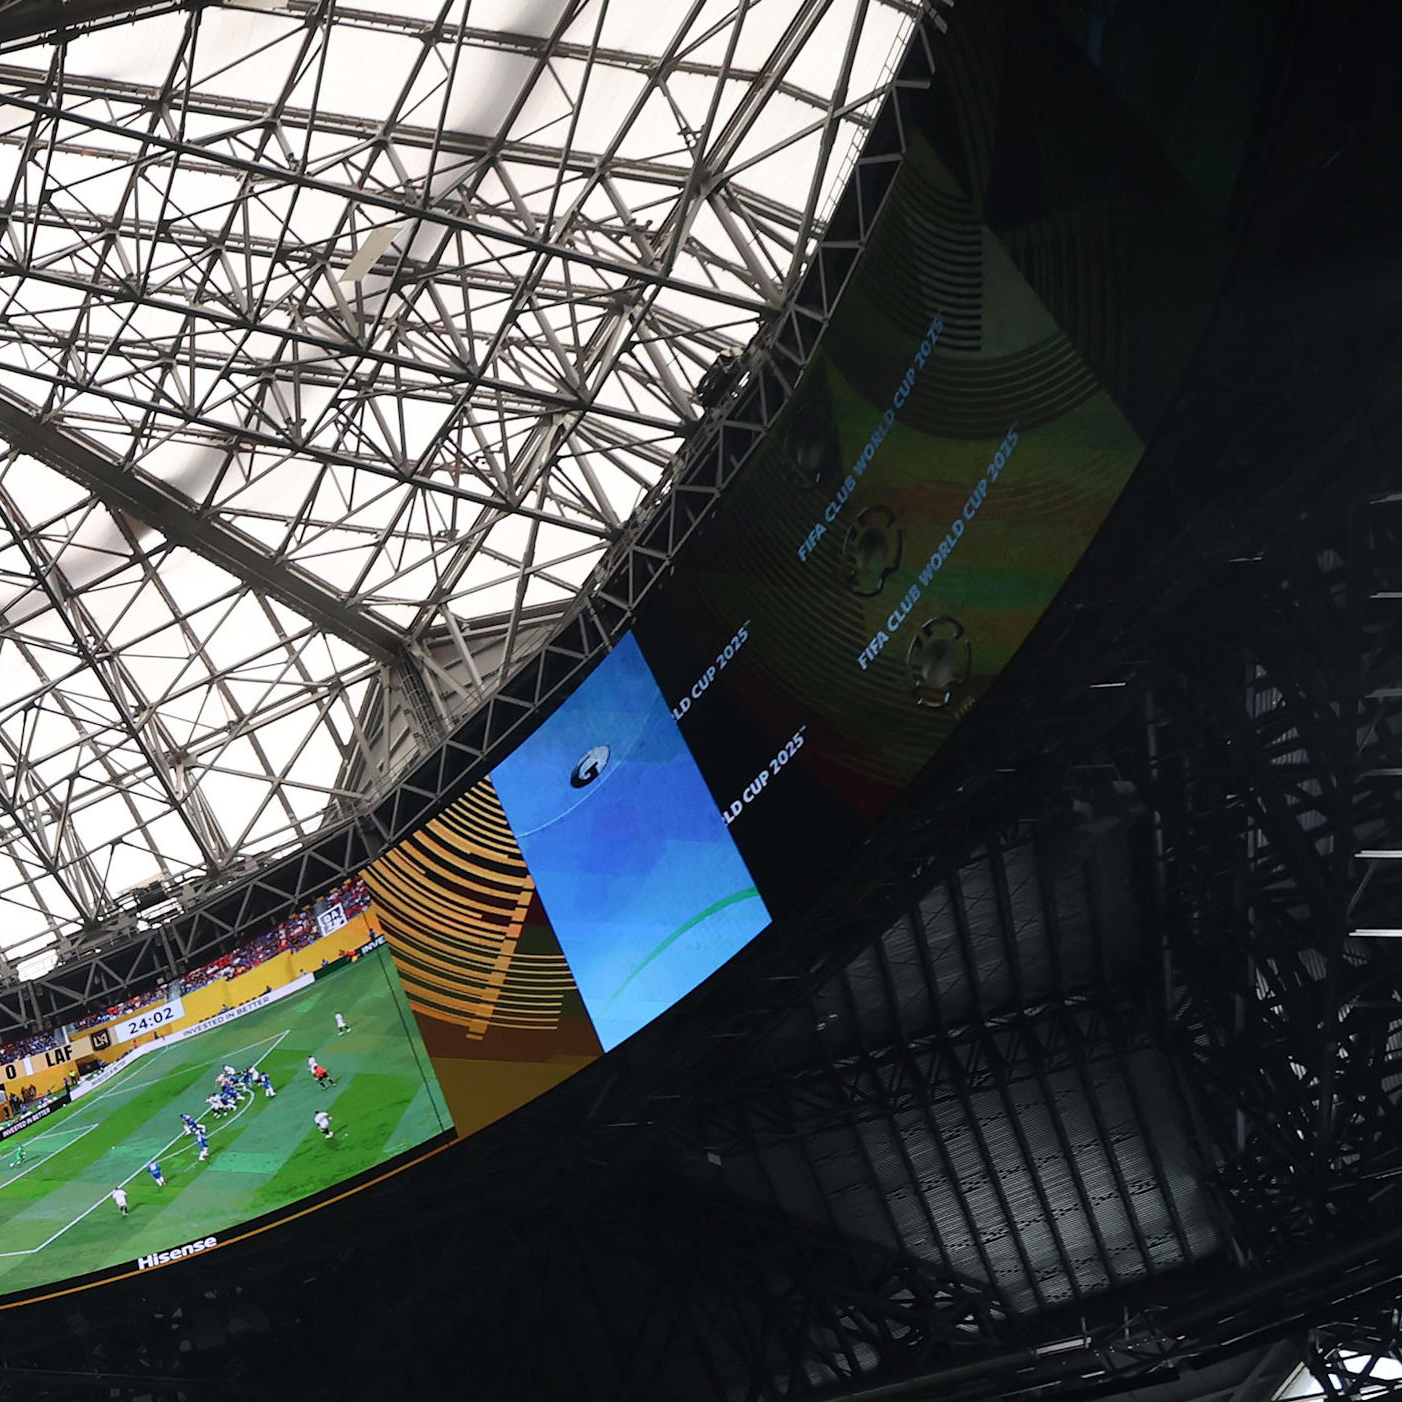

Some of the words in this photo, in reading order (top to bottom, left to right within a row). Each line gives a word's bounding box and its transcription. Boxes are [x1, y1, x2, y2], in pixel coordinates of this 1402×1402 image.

[742, 770, 768, 802] CUP
[128, 1007, 174, 1035] 24:02
[5, 1064, 17, 1079] 0
[45, 1046, 72, 1067] LAF
[138, 1237, 216, 1269] Hisense
